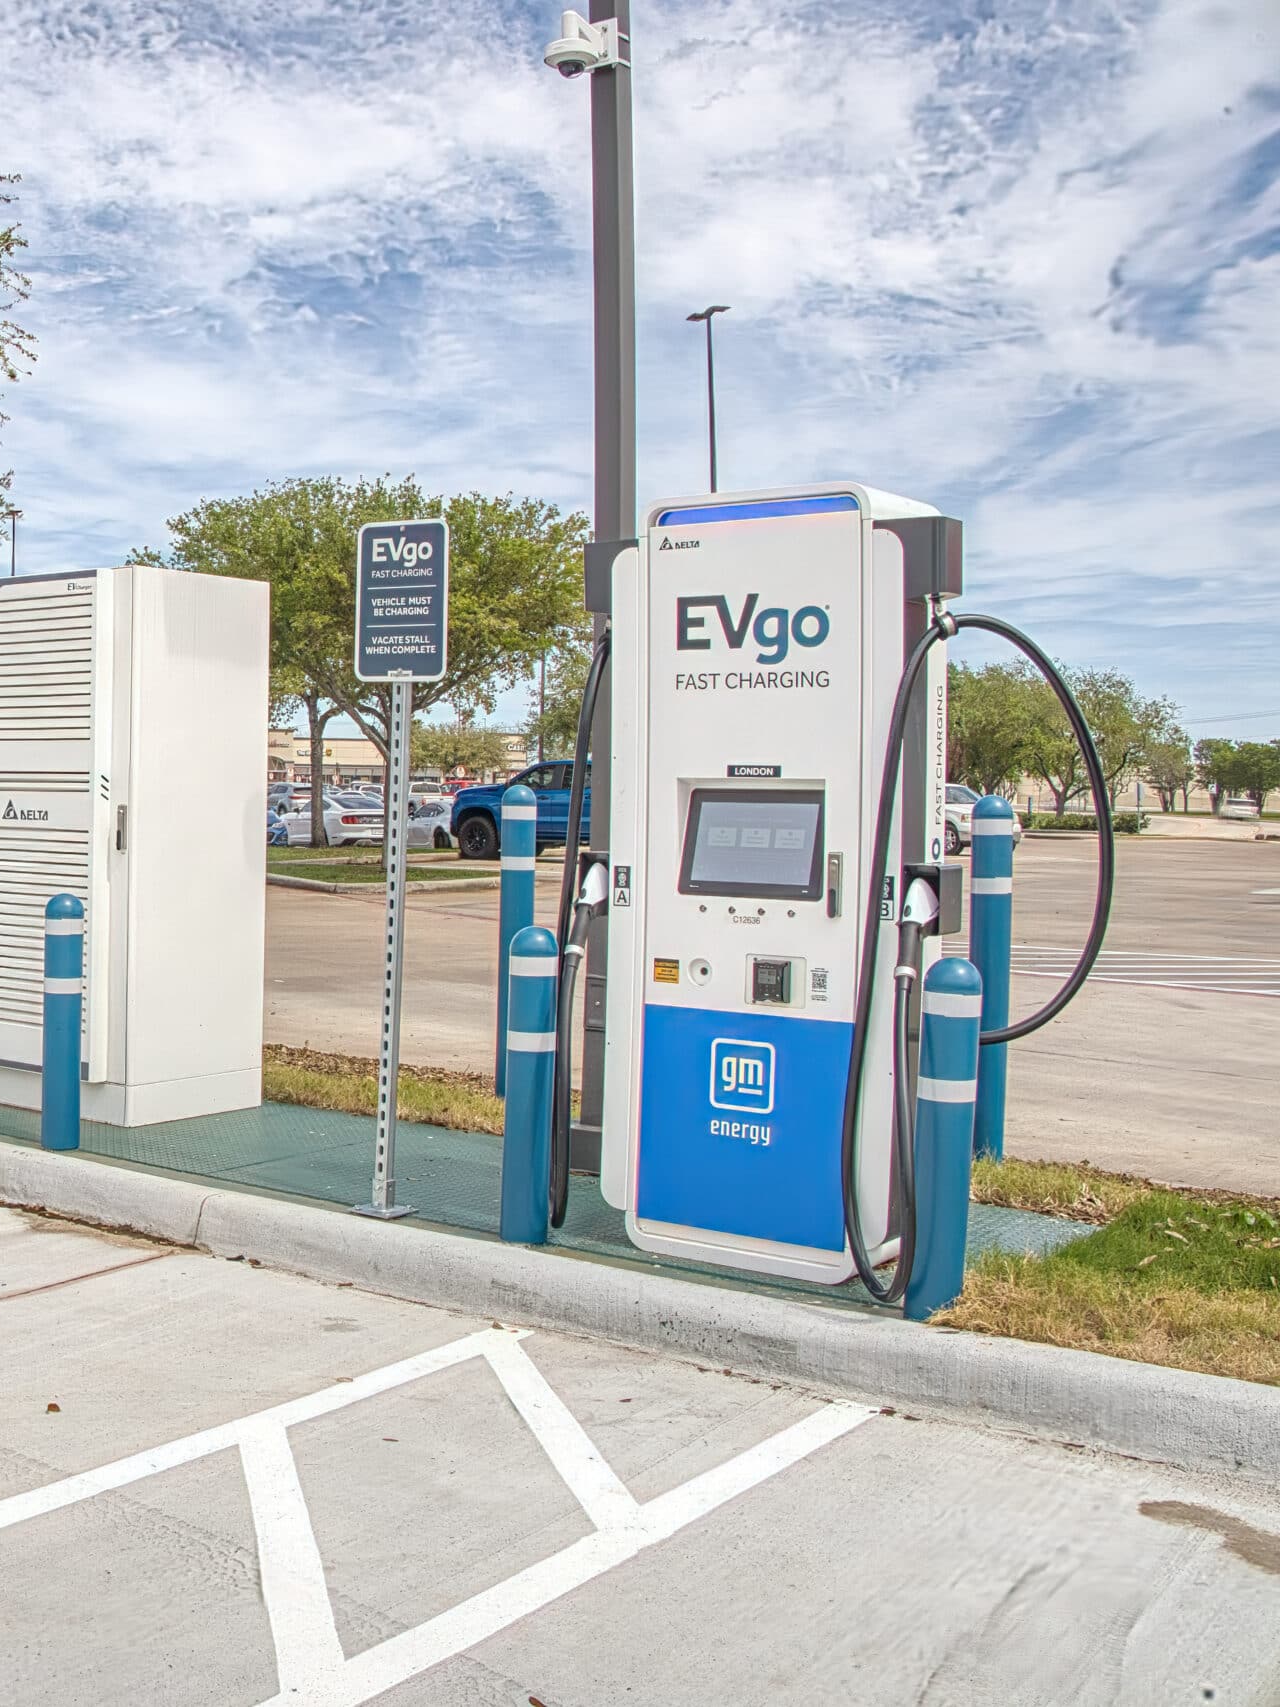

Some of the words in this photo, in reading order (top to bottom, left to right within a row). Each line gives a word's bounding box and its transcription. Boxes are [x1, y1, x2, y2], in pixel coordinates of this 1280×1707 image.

[675, 541, 700, 549] DELTA
[372, 537, 433, 567] EVgo
[371, 569, 389, 578] FAST
[391, 568, 433, 578] CHARGING
[371, 598, 405, 607] VEHICLE
[408, 596, 432, 605] MUST
[373, 608, 384, 616] BE
[385, 606, 429, 616] CHARGING
[677, 593, 830, 665] EVgo
[372, 636, 404, 644] VACATE
[404, 635, 430, 644] STALL
[365, 646, 391, 655] WHEN
[391, 645, 437, 654] COMPLETE
[675, 673, 721, 690] FAST
[725, 671, 830, 690] CHARGING
[935, 685, 943, 779] CHARGING
[734, 767, 774, 776] LONDON
[935, 783, 943, 825] FAST
[20, 809, 48, 821] DELTA
[616, 889, 628, 903] A
[721, 1056, 764, 1095] gm
[710, 1119, 771, 1146] energy
